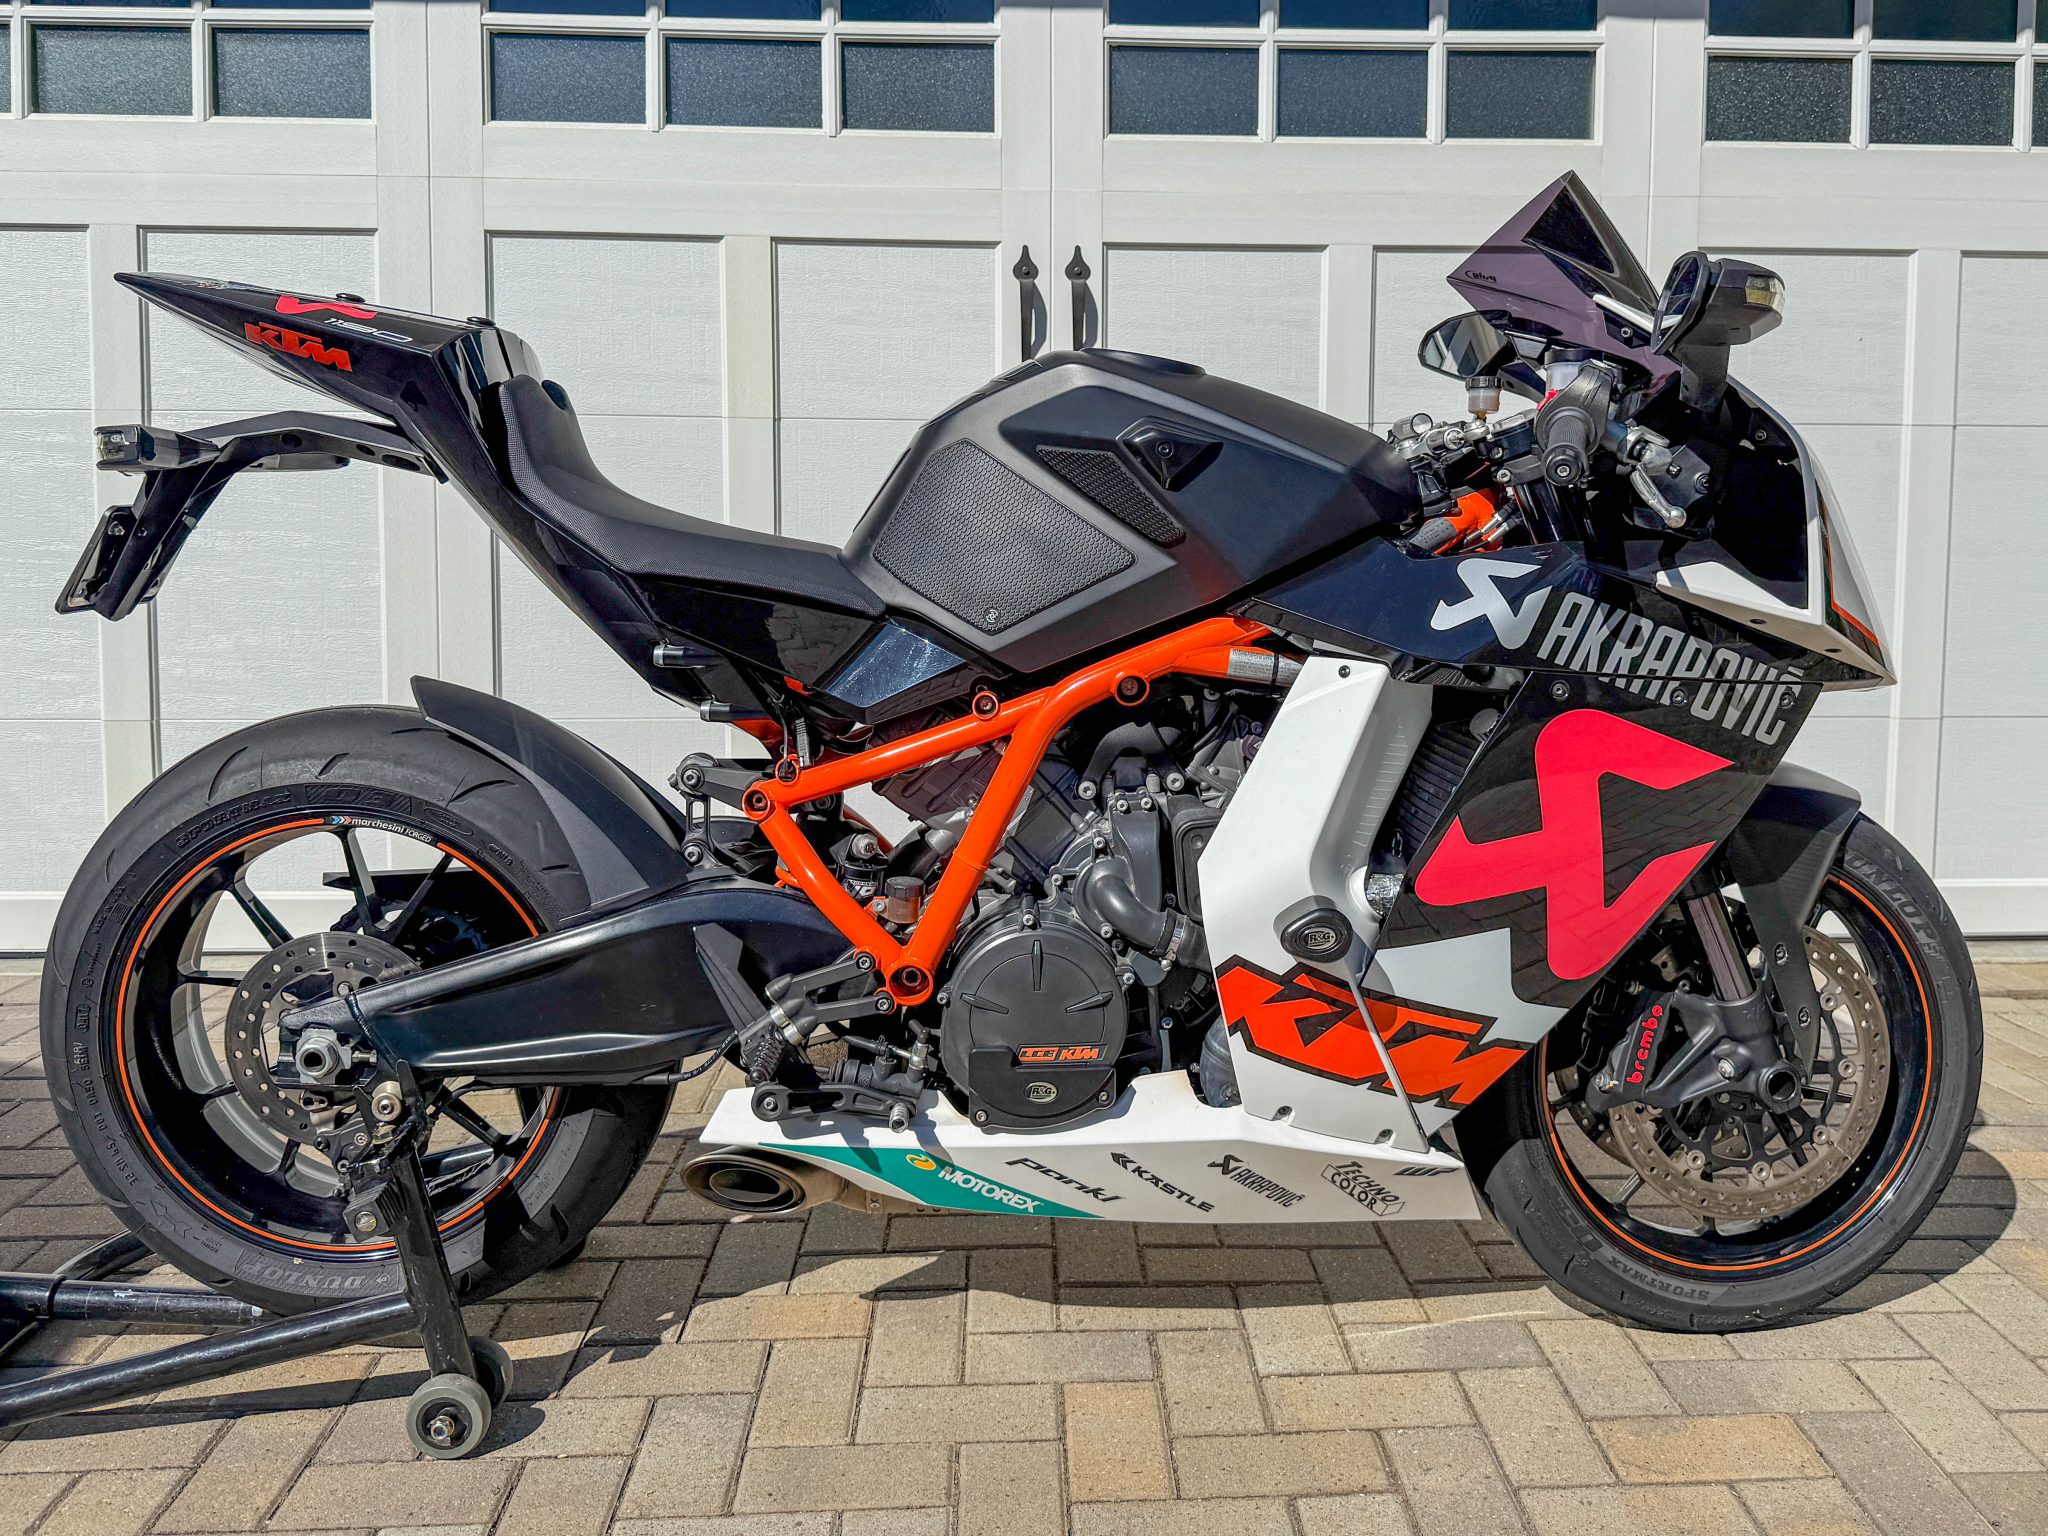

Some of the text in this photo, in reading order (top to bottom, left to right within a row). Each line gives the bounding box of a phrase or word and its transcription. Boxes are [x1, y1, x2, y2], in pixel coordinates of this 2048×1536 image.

[244, 321, 352, 372] KTM
[324, 317, 413, 343] 1190
[351, 817, 432, 843] marchesini FORGED
[1846, 853, 1939, 940] UNLOP
[1059, 1046, 1100, 1060] KTM
[1217, 964, 1529, 1105] KTM
[1626, 1004, 1663, 1085] brembo
[938, 1167, 1041, 1213] MOTOREX
[1330, 1172, 1377, 1210] COLOR
[1335, 1161, 1400, 1202] TECHNO
[240, 1261, 365, 1290] DUNLOP
